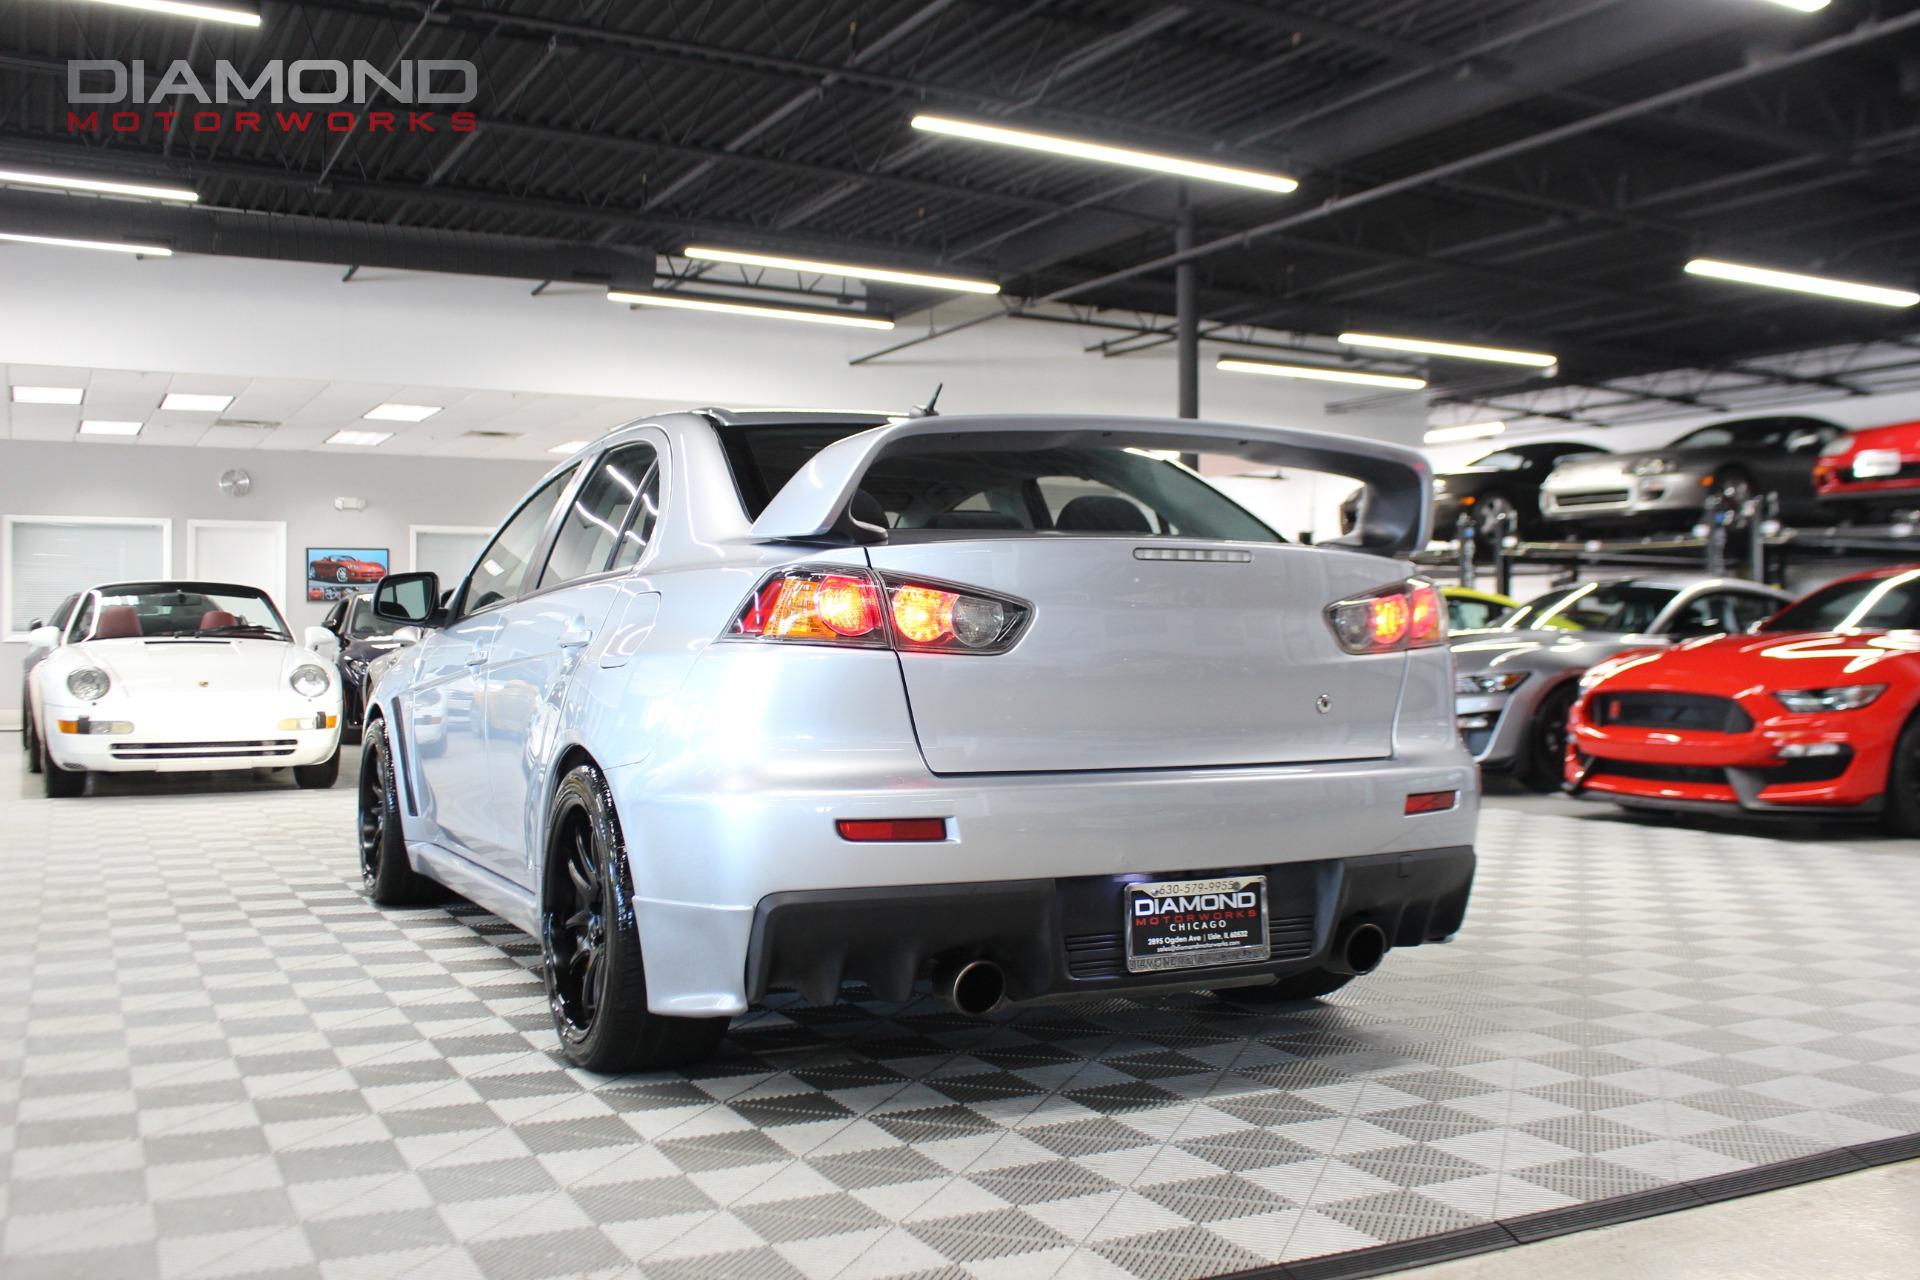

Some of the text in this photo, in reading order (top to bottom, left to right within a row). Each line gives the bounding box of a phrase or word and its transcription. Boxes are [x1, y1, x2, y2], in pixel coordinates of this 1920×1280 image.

[1134, 892, 1256, 916] DIAMOND
[1135, 909, 1257, 926] MOTORWORKS
[1169, 919, 1227, 932] CHICAGO
[1147, 937, 1164, 946] 2895
[1164, 935, 1188, 945] Ogden
[1188, 934, 1202, 942] Ave
